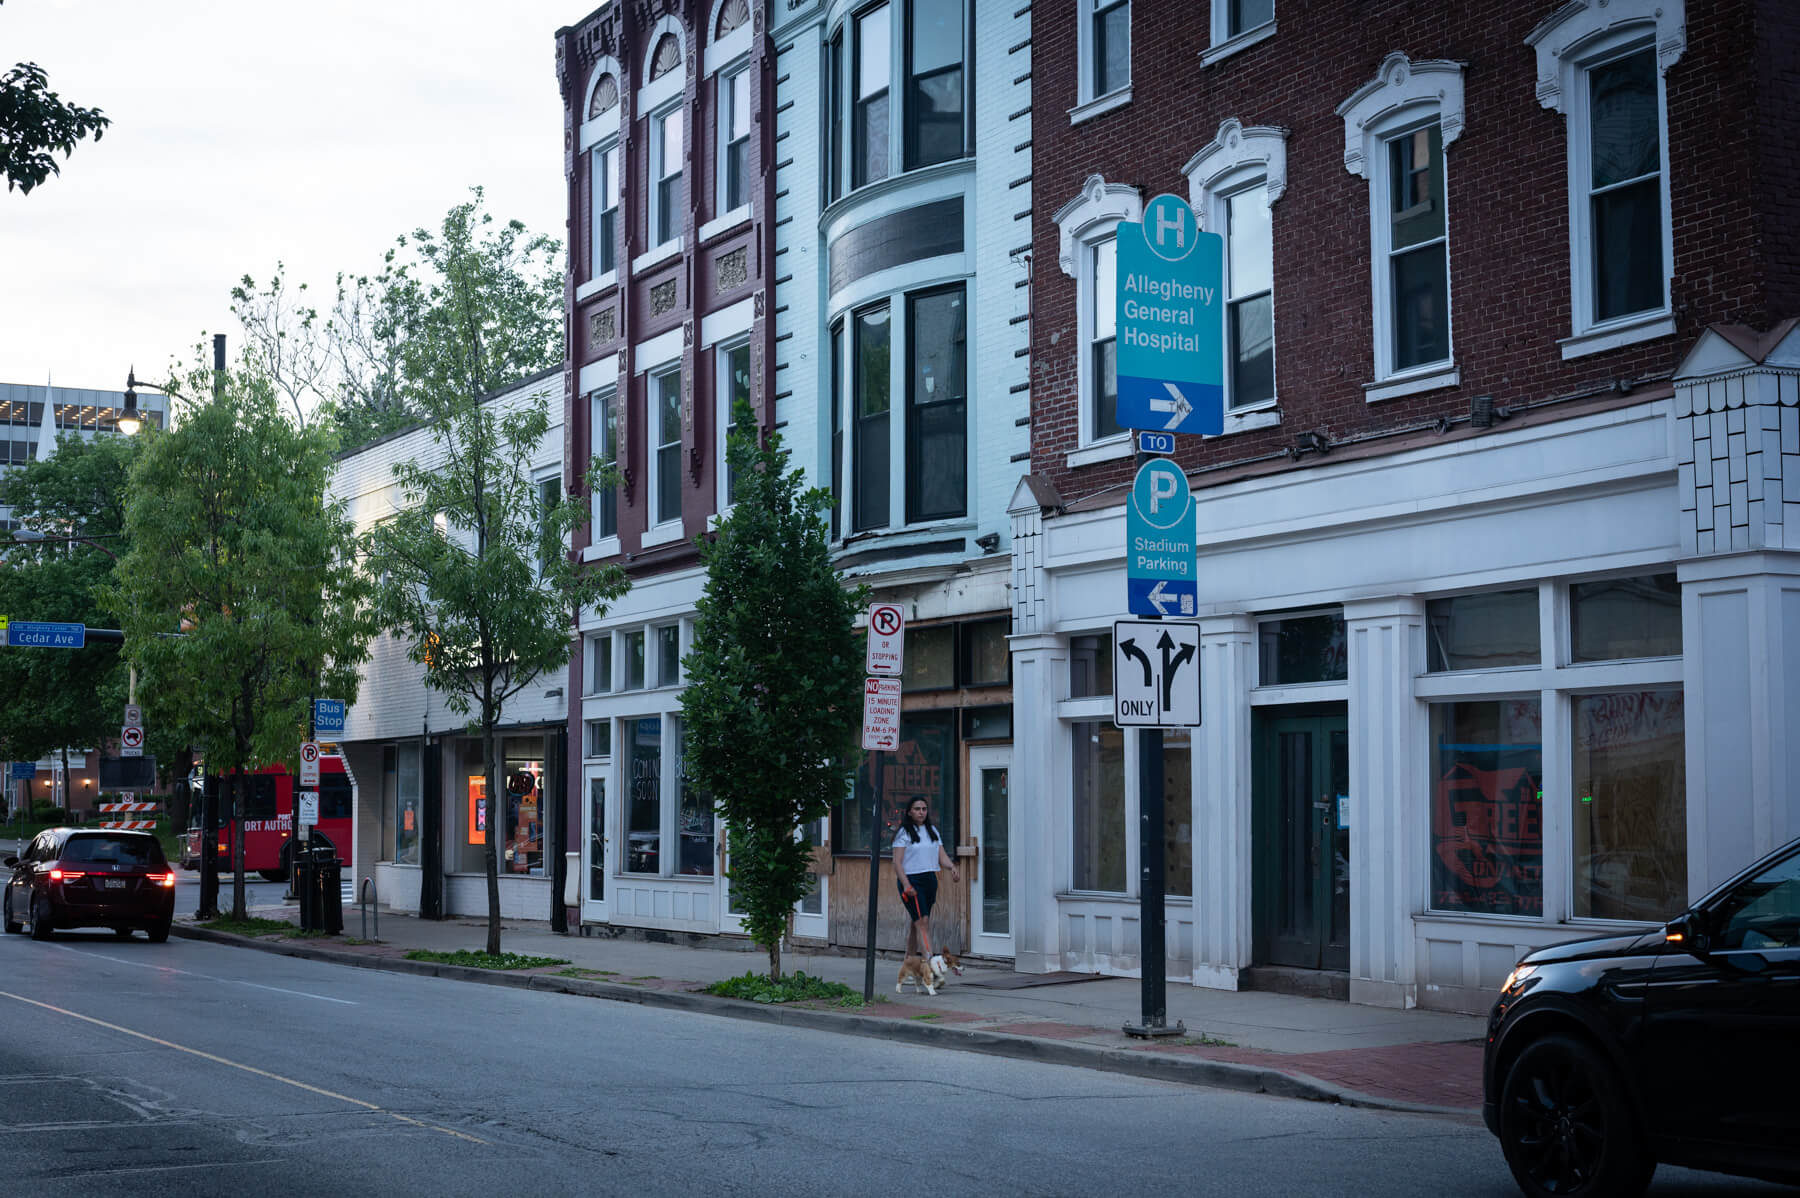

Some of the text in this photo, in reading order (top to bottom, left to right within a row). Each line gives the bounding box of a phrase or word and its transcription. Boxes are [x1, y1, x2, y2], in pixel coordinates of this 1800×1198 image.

[1156, 205, 1184, 248] H
[1124, 273, 1214, 305] Allegheny
[1124, 301, 1194, 326] General
[1124, 327, 1199, 352] Hospital
[1148, 436, 1167, 449] TO
[1150, 471, 1177, 514] P
[1135, 537, 1189, 553] Stadium
[1137, 556, 1188, 574] Parking
[19, 633, 74, 644] Cedar Ave
[872, 653, 898, 661] STOPPING
[866, 681, 878, 692] NO
[320, 703, 340, 712] Bus
[877, 698, 897, 706] MINUTE
[1121, 700, 1154, 716] ONLY
[317, 715, 342, 727] Stop
[632, 758, 660, 779] COMIN
[637, 781, 658, 800] SOON
[244, 820, 292, 831] ORT AUTHO
